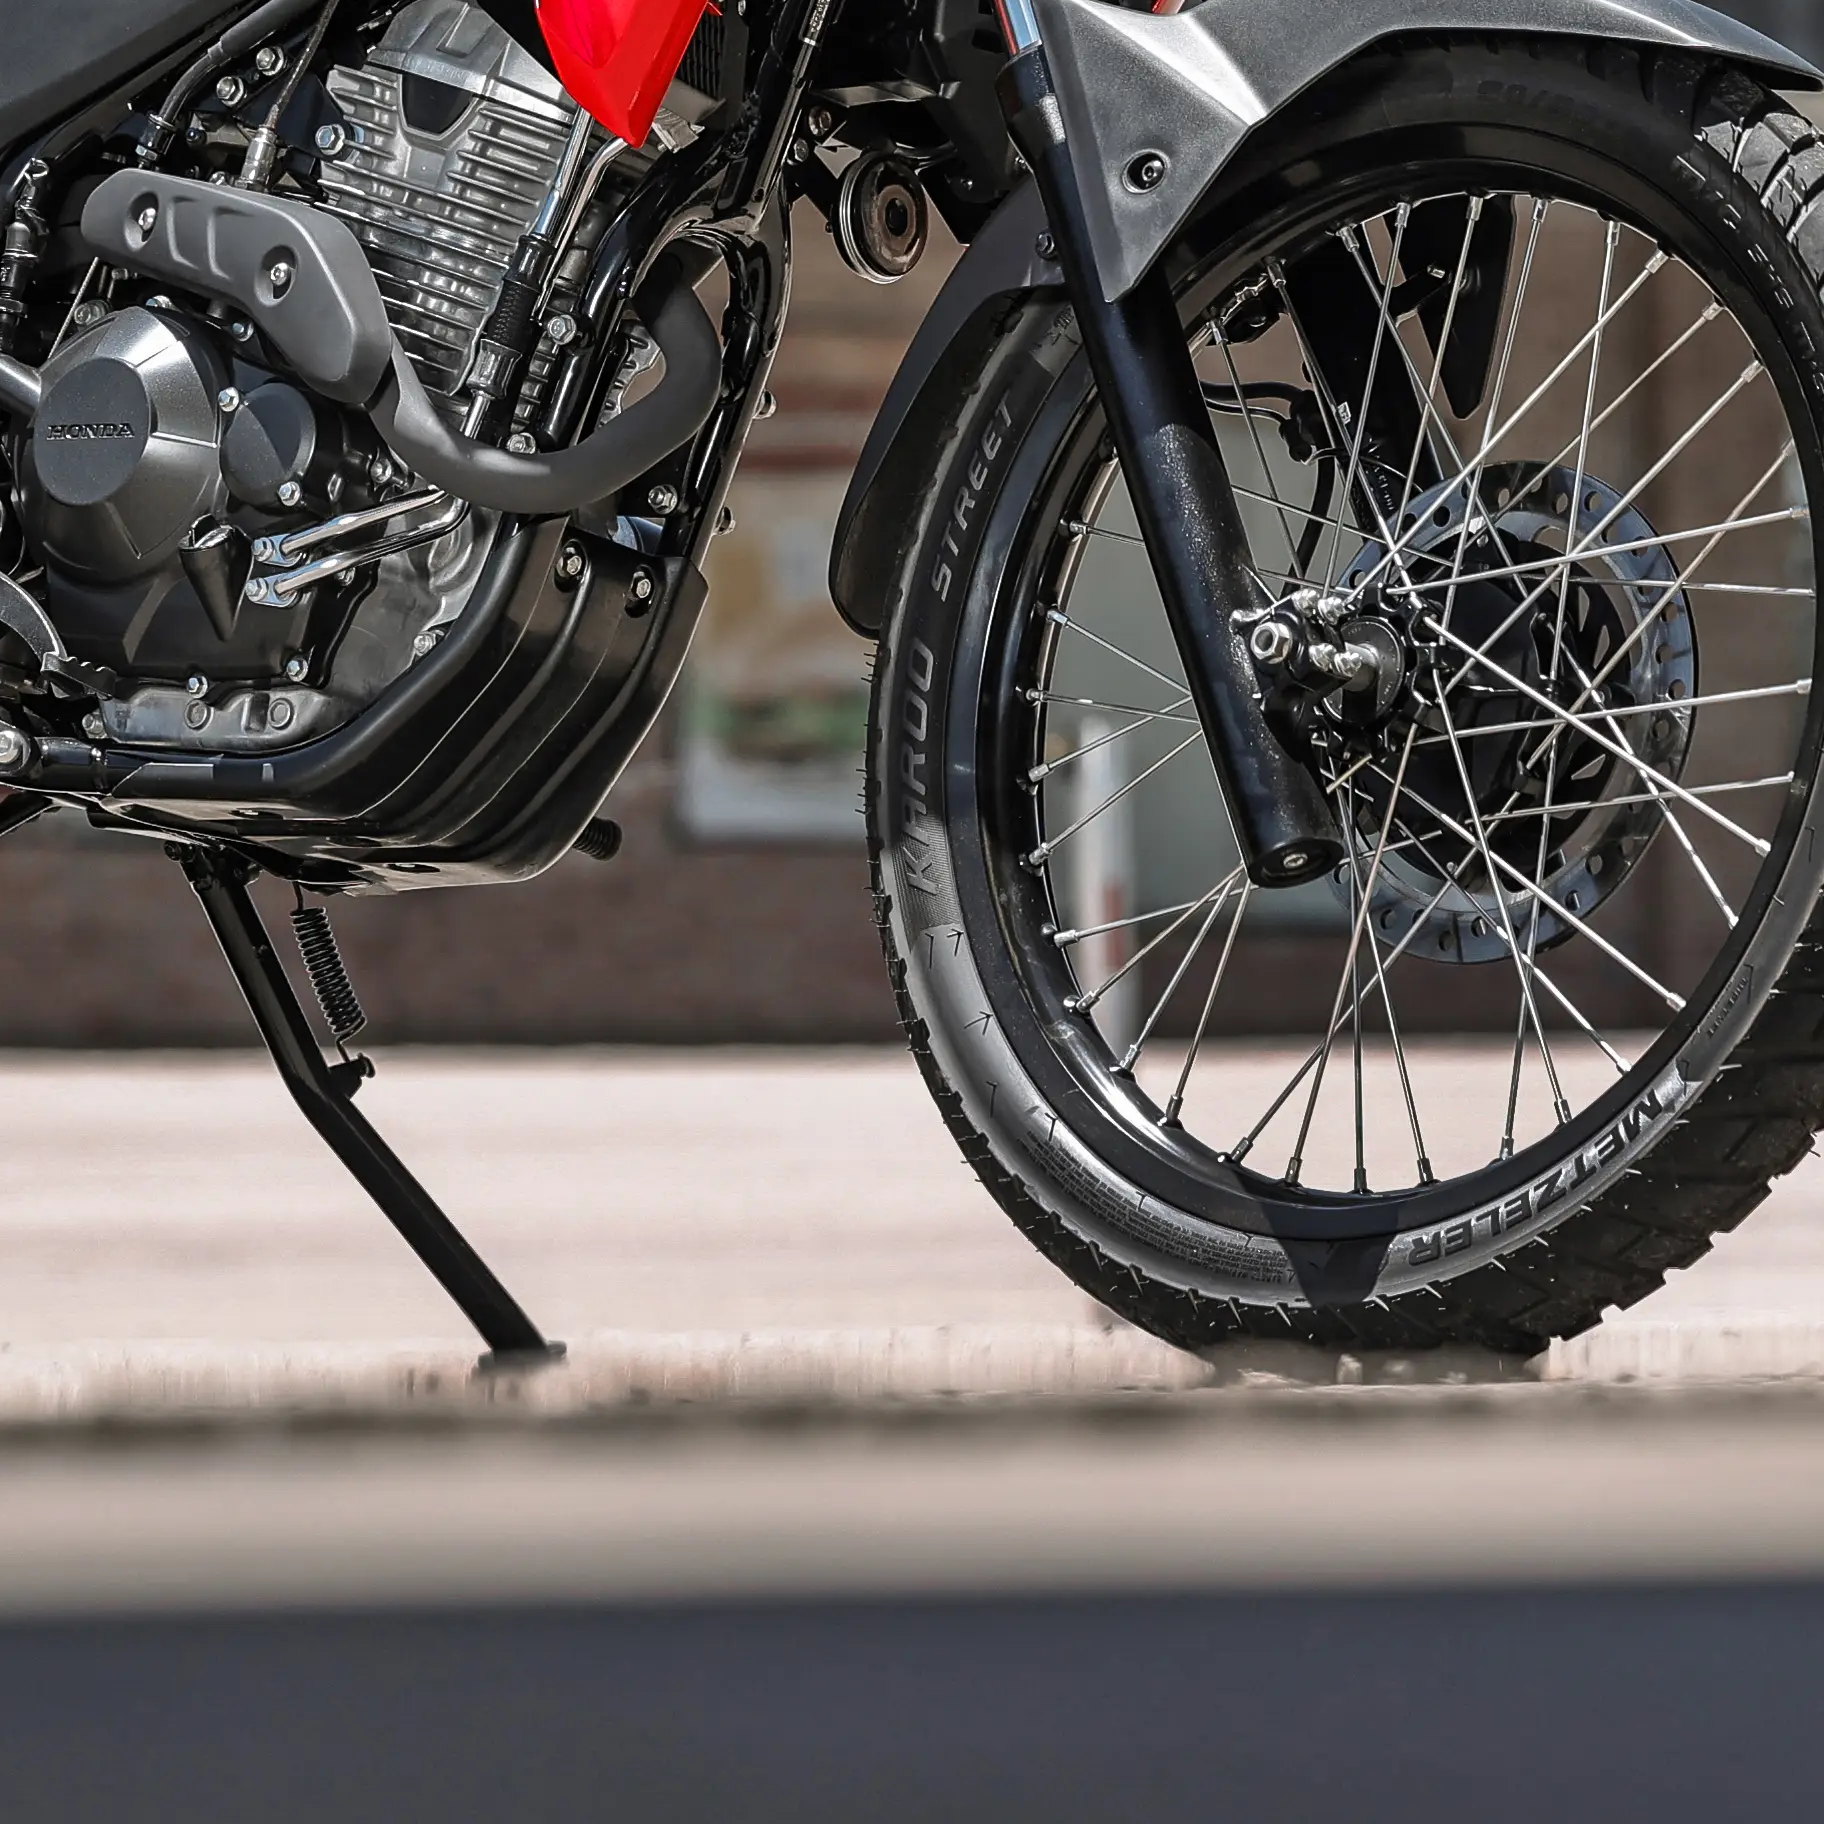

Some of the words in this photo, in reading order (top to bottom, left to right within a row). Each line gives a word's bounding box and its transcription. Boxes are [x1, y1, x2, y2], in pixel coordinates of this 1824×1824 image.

[46, 421, 135, 440] HONDA
[898, 637, 938, 896] KAROO
[930, 391, 1014, 603] STREET
[1407, 1087, 1664, 1267] METZELER
